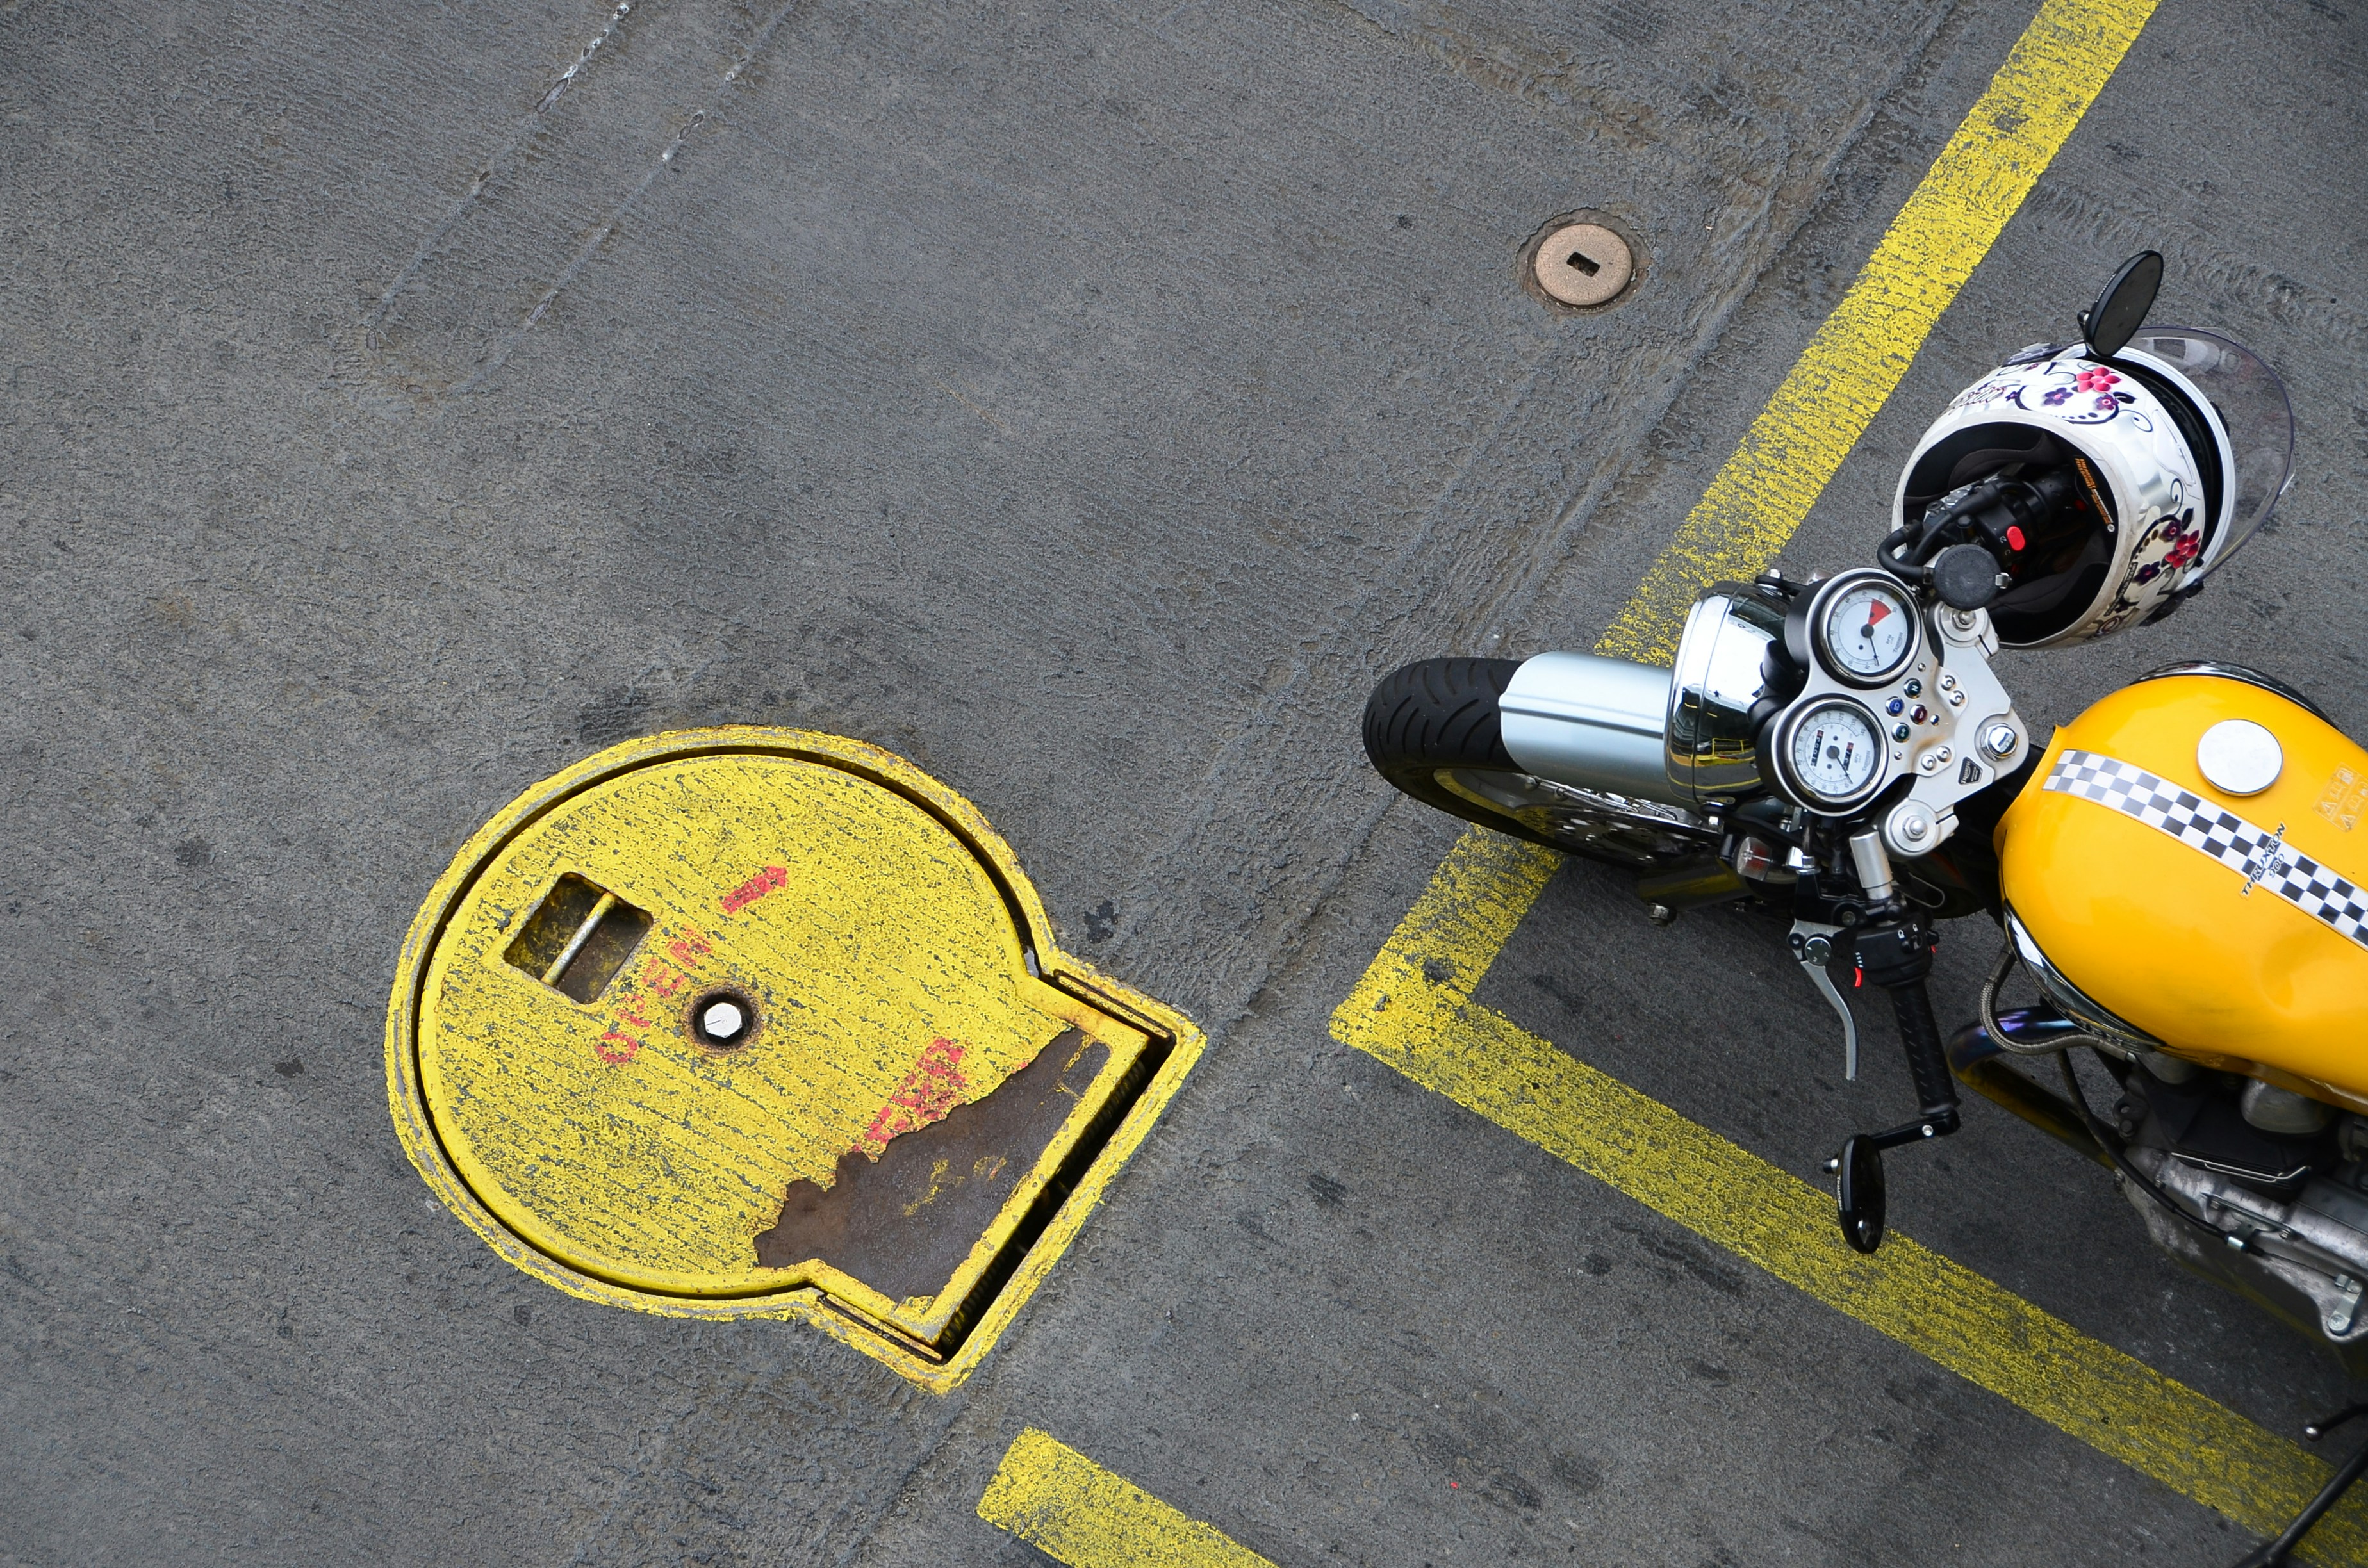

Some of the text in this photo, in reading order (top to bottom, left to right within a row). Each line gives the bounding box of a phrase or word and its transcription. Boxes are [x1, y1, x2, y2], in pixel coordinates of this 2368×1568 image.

[1961, 760, 1971, 784] TRIUMPH
[2241, 822, 2286, 895] THRUXTON
[2269, 853, 2285, 878] 900
[596, 924, 712, 1064] OPEN
